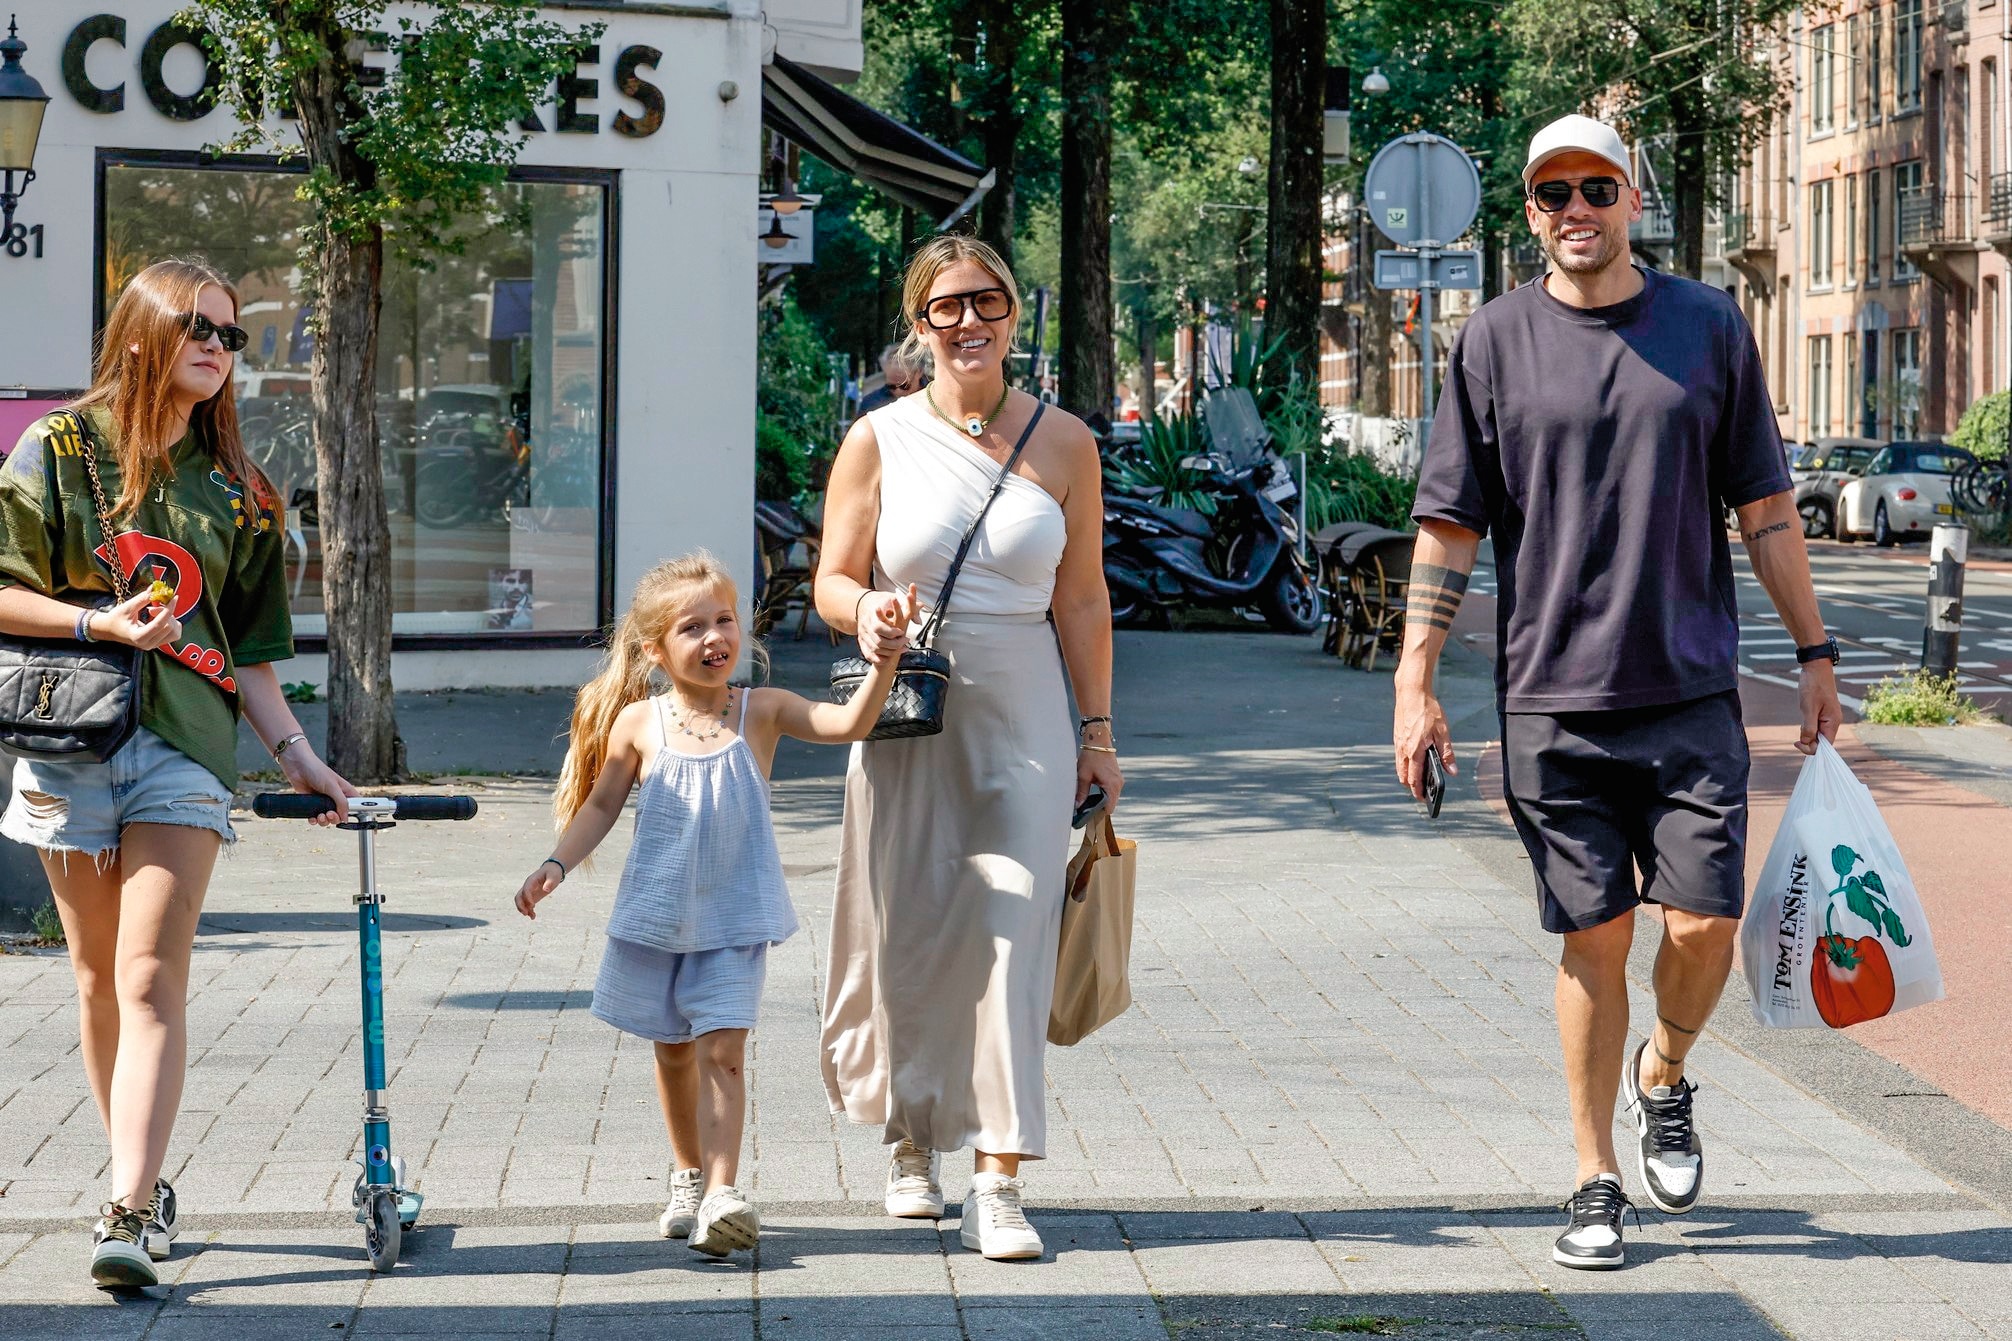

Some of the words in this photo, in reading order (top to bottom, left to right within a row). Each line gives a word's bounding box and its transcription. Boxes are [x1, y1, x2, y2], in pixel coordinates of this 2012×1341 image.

[1747, 521, 1791, 541] LENNOX
[1795, 881, 1810, 967] GROENTENIER
[365, 938, 384, 1045] micro
[1773, 941, 1794, 991] TOM
